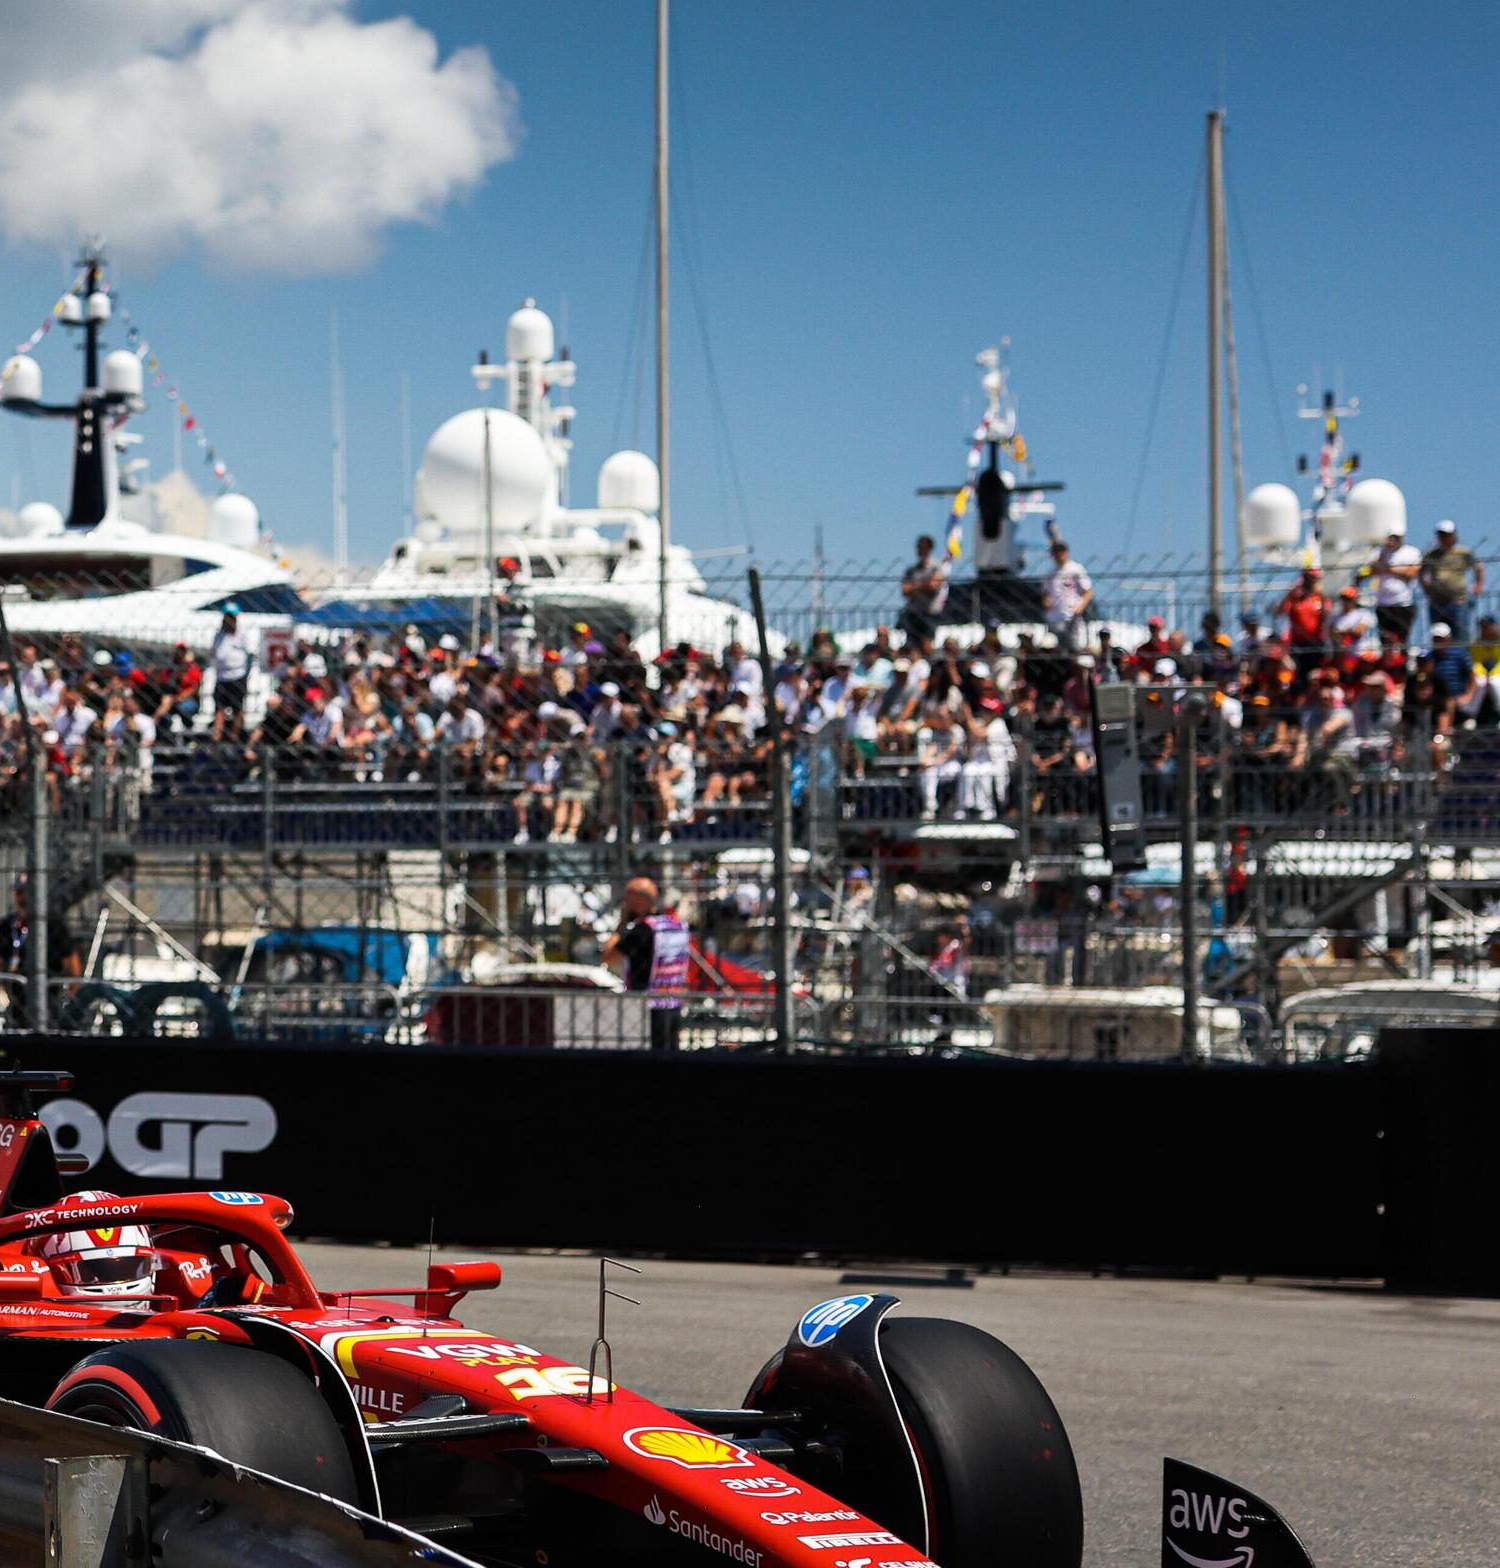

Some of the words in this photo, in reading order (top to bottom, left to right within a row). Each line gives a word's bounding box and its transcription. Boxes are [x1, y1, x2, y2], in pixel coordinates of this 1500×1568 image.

[56, 1204, 138, 1219] TECHNOLOGY
[39, 1309, 91, 1319] AUTOMOTIVE
[803, 1297, 861, 1345] hp
[386, 1343, 544, 1360] VGW
[453, 1355, 540, 1367] PLAY
[493, 1366, 618, 1401] 16
[719, 1476, 787, 1490] aws
[781, 1510, 861, 1523] Palantir
[1169, 1488, 1250, 1539] aws
[669, 1510, 764, 1568] Santander
[796, 1531, 905, 1550] PIRELLI
